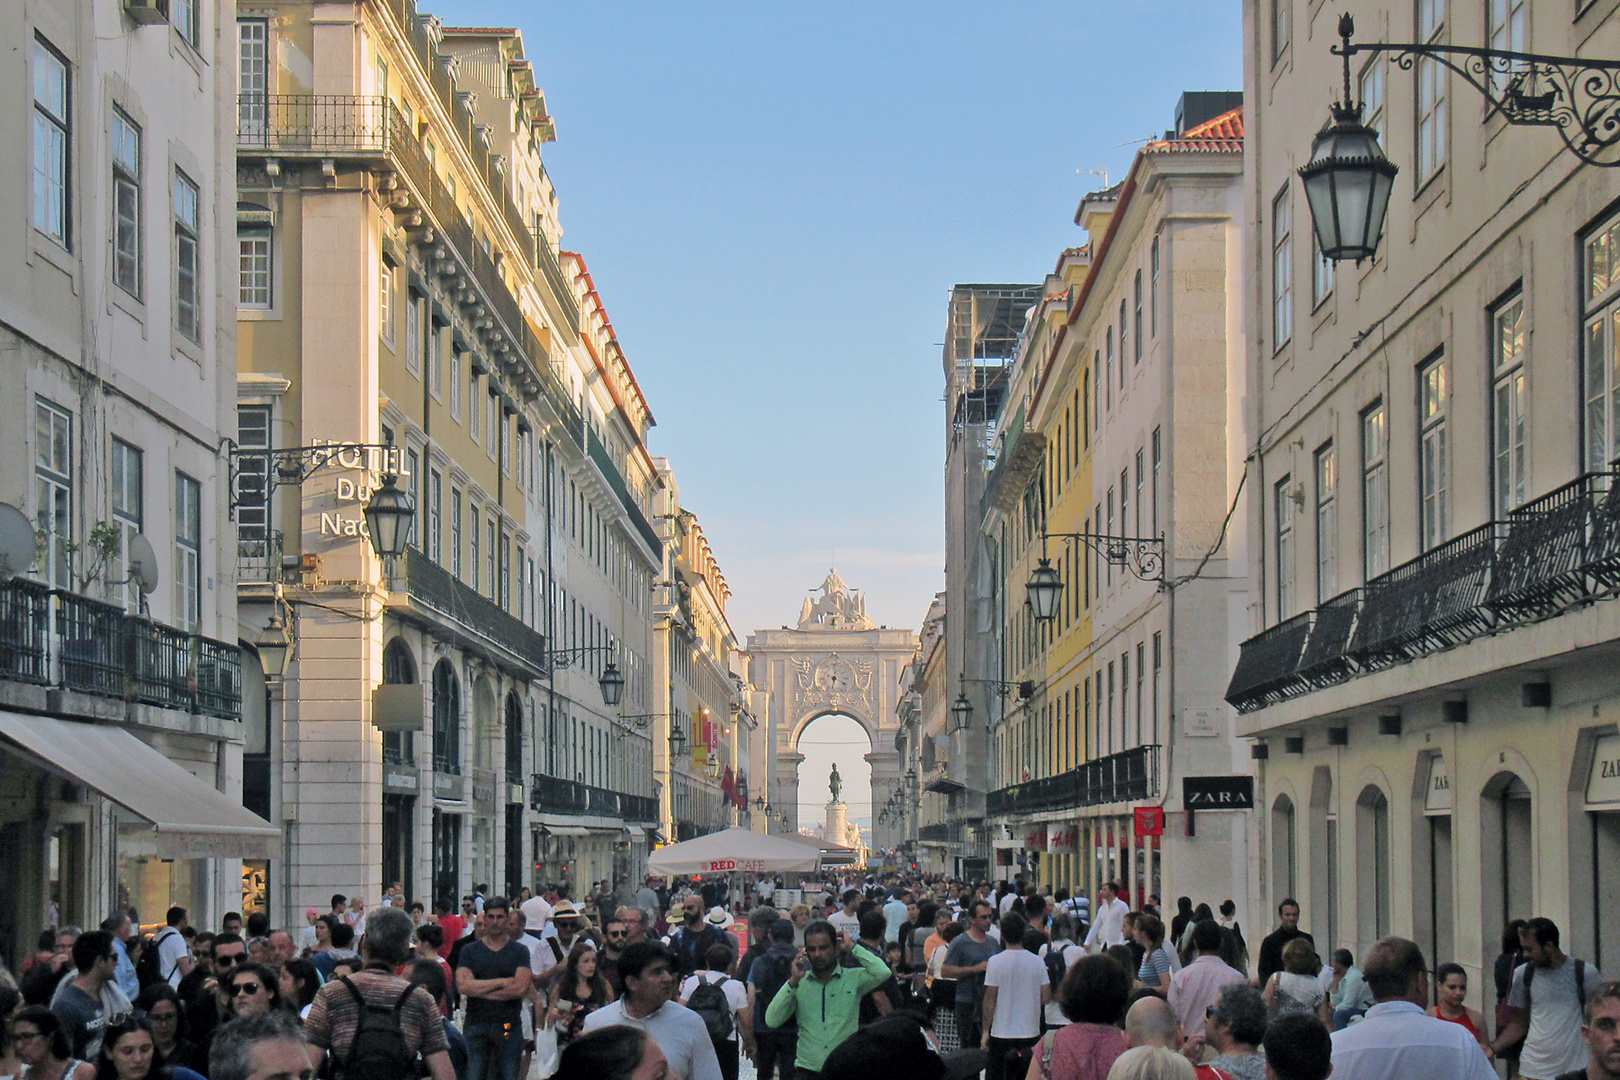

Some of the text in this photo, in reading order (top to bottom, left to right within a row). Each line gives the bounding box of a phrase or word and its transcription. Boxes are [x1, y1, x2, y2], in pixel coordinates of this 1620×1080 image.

[312, 438, 411, 476] HOTEL
[321, 512, 371, 542] Naç
[1601, 758, 1620, 778] ZAR
[1189, 791, 1247, 804] ZARA
[710, 860, 736, 871] RED
